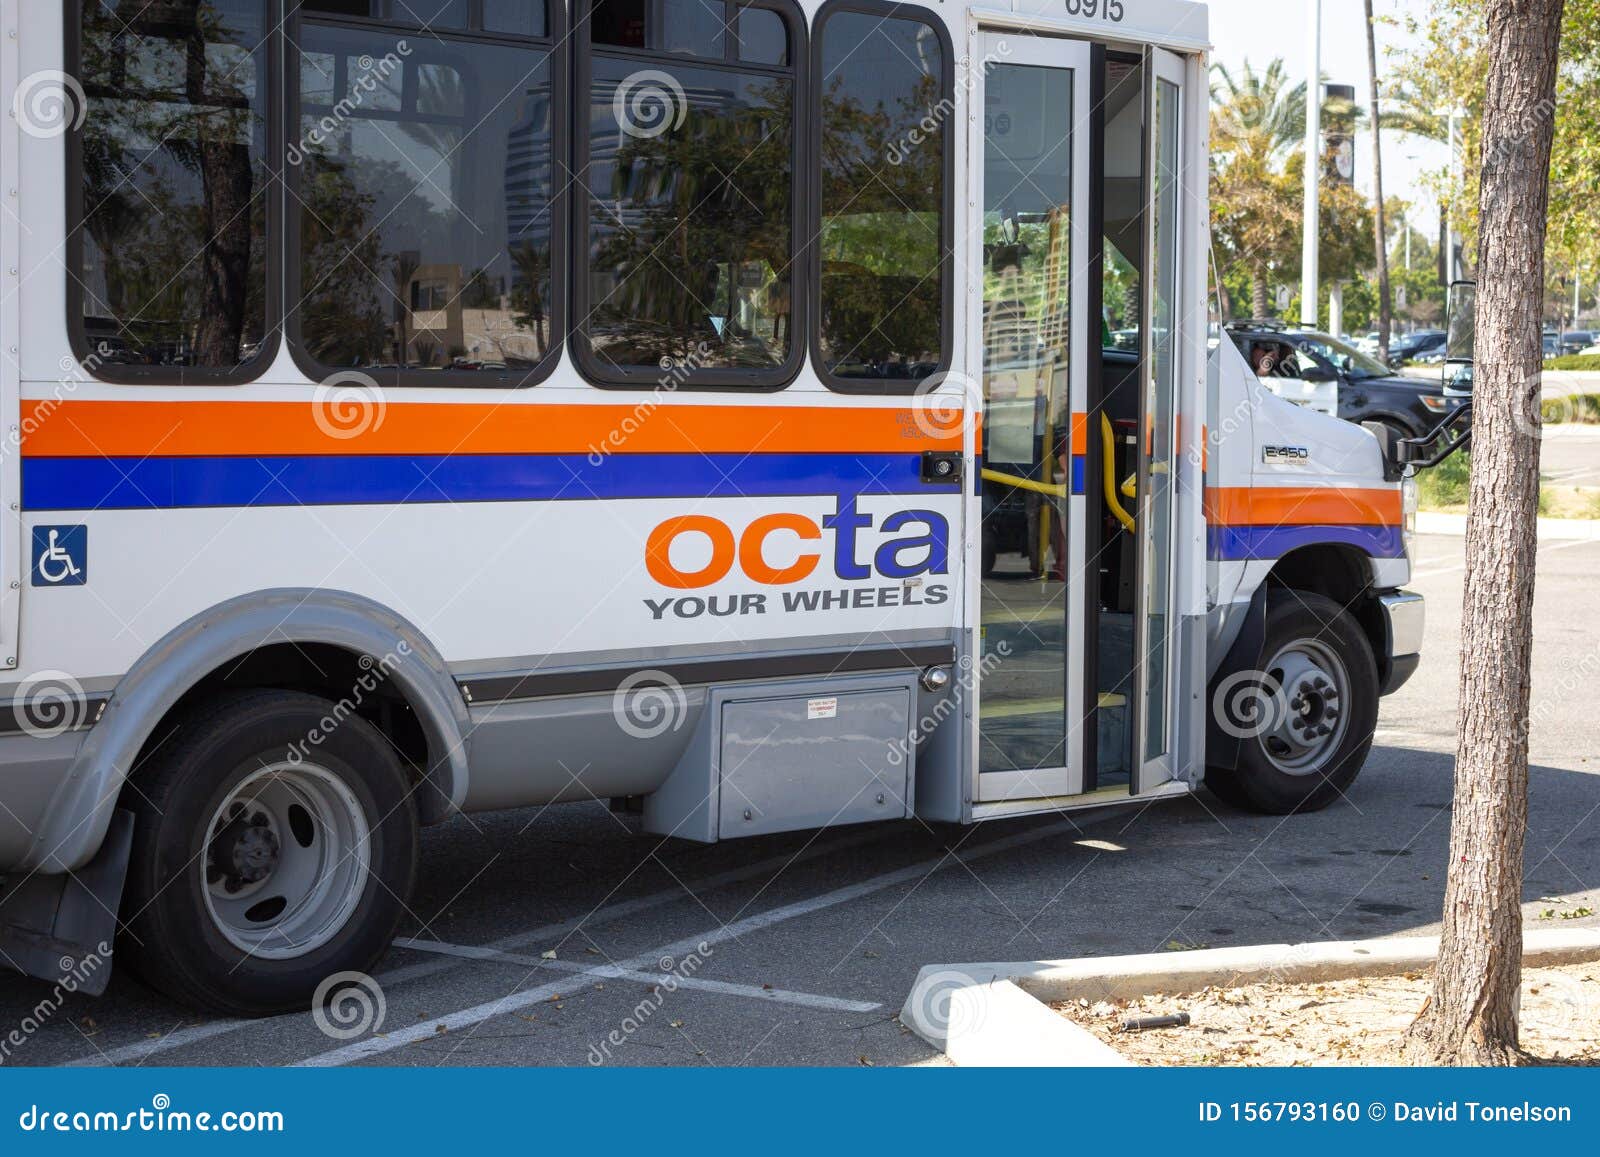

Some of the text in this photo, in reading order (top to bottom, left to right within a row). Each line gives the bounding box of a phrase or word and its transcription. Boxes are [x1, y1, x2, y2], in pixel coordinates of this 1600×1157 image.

[645, 496, 949, 589] octa
[643, 584, 949, 620] YOUR WHEELS
